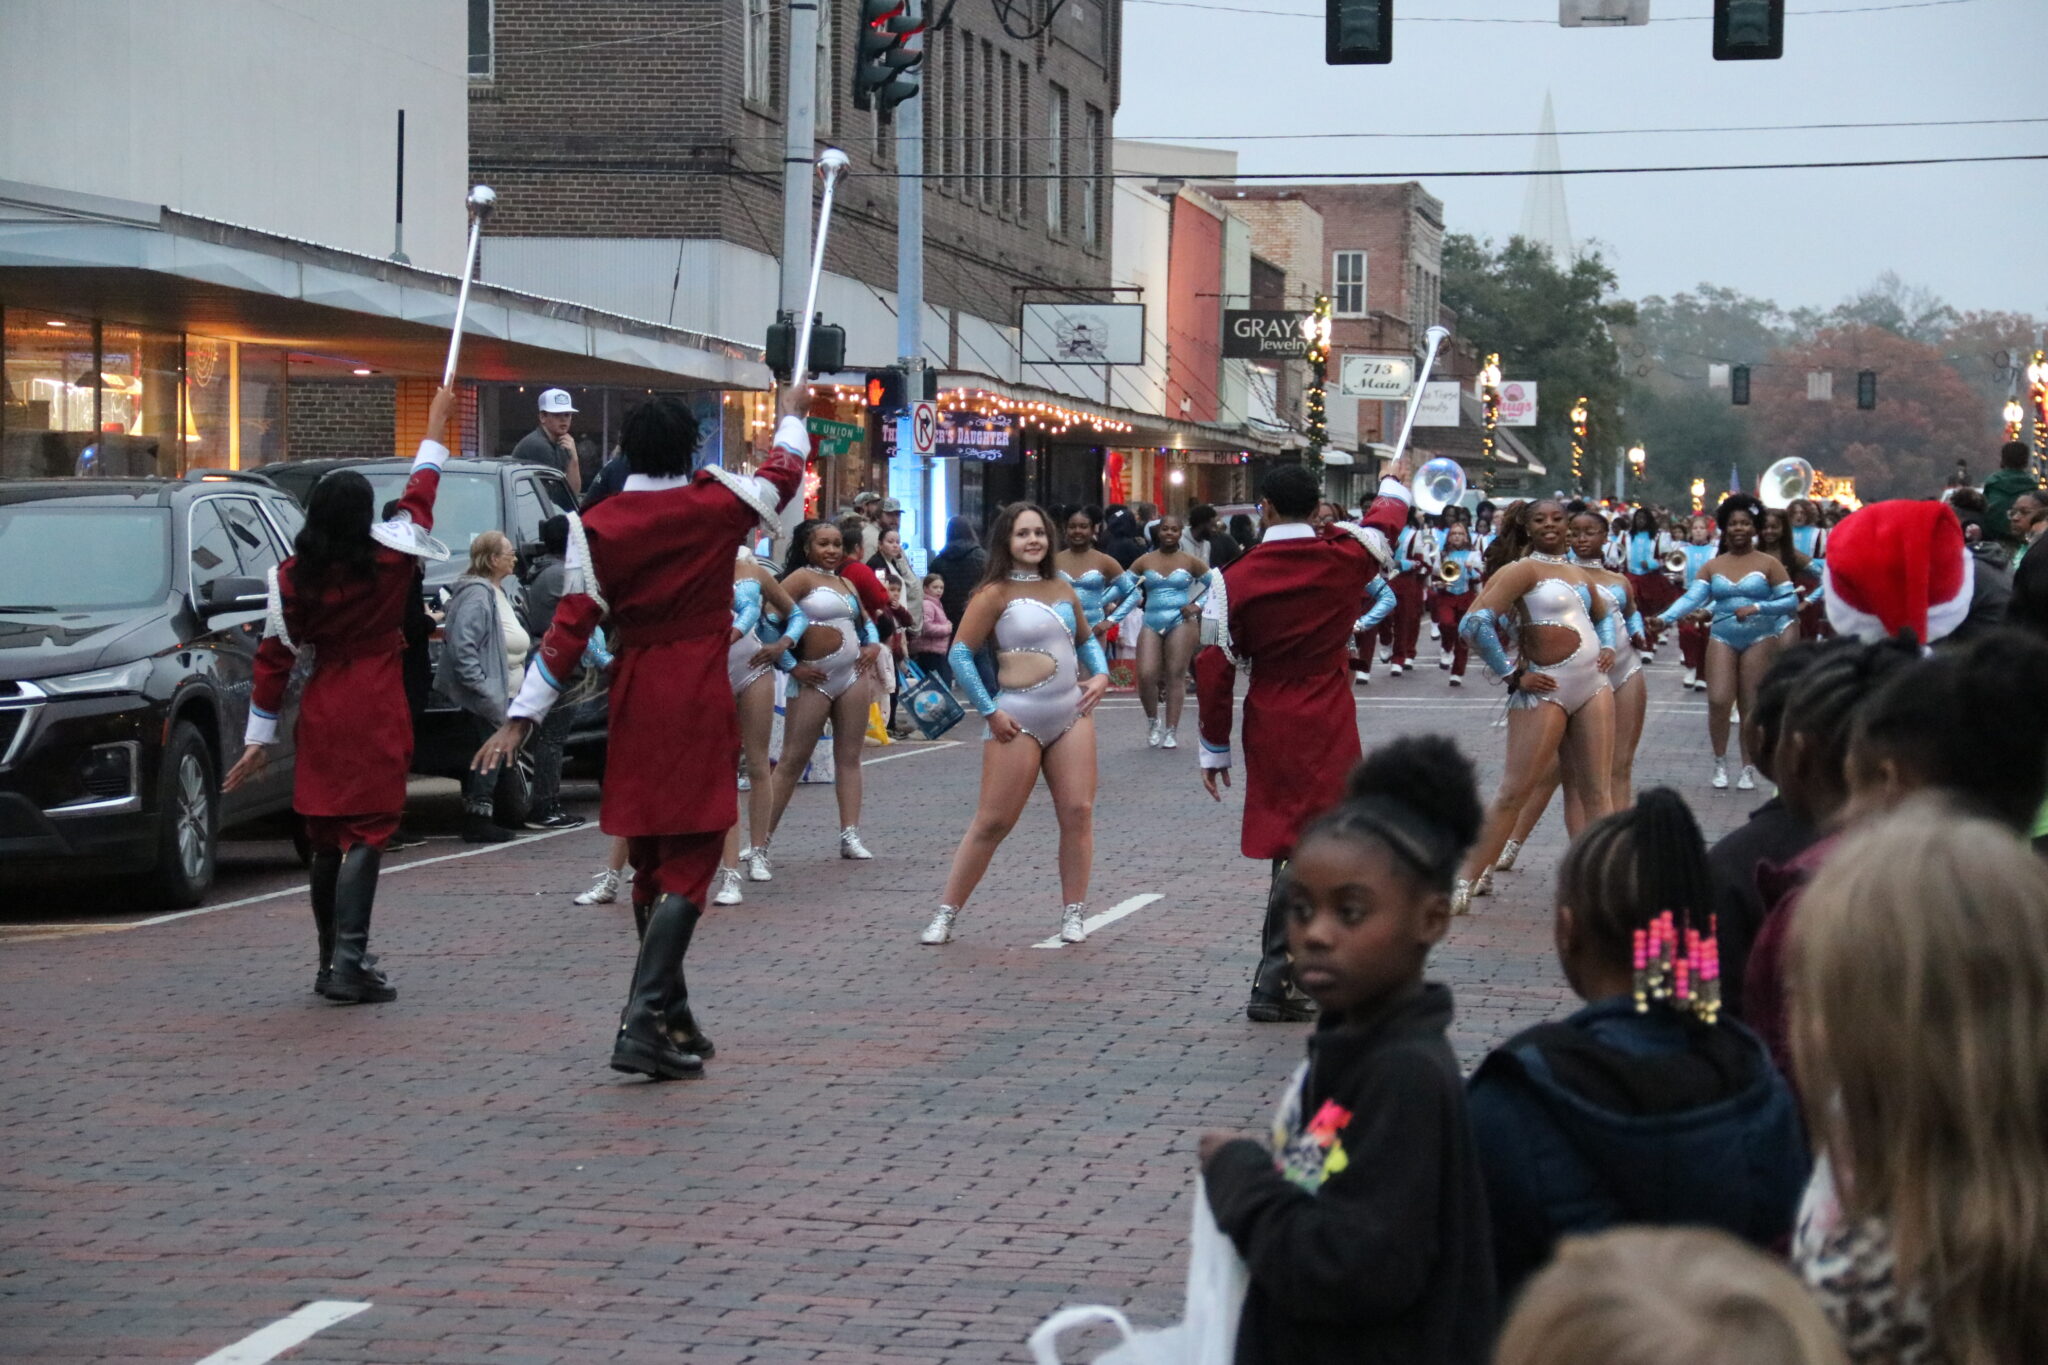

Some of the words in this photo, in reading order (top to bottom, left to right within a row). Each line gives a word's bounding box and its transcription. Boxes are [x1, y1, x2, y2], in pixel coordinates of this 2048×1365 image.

[1259, 337, 1308, 354] Jewelry
[1363, 363, 1393, 374] 713
[1353, 378, 1400, 389] Main
[823, 424, 854, 438] UNION
[957, 427, 1009, 446] DAUGHTER
